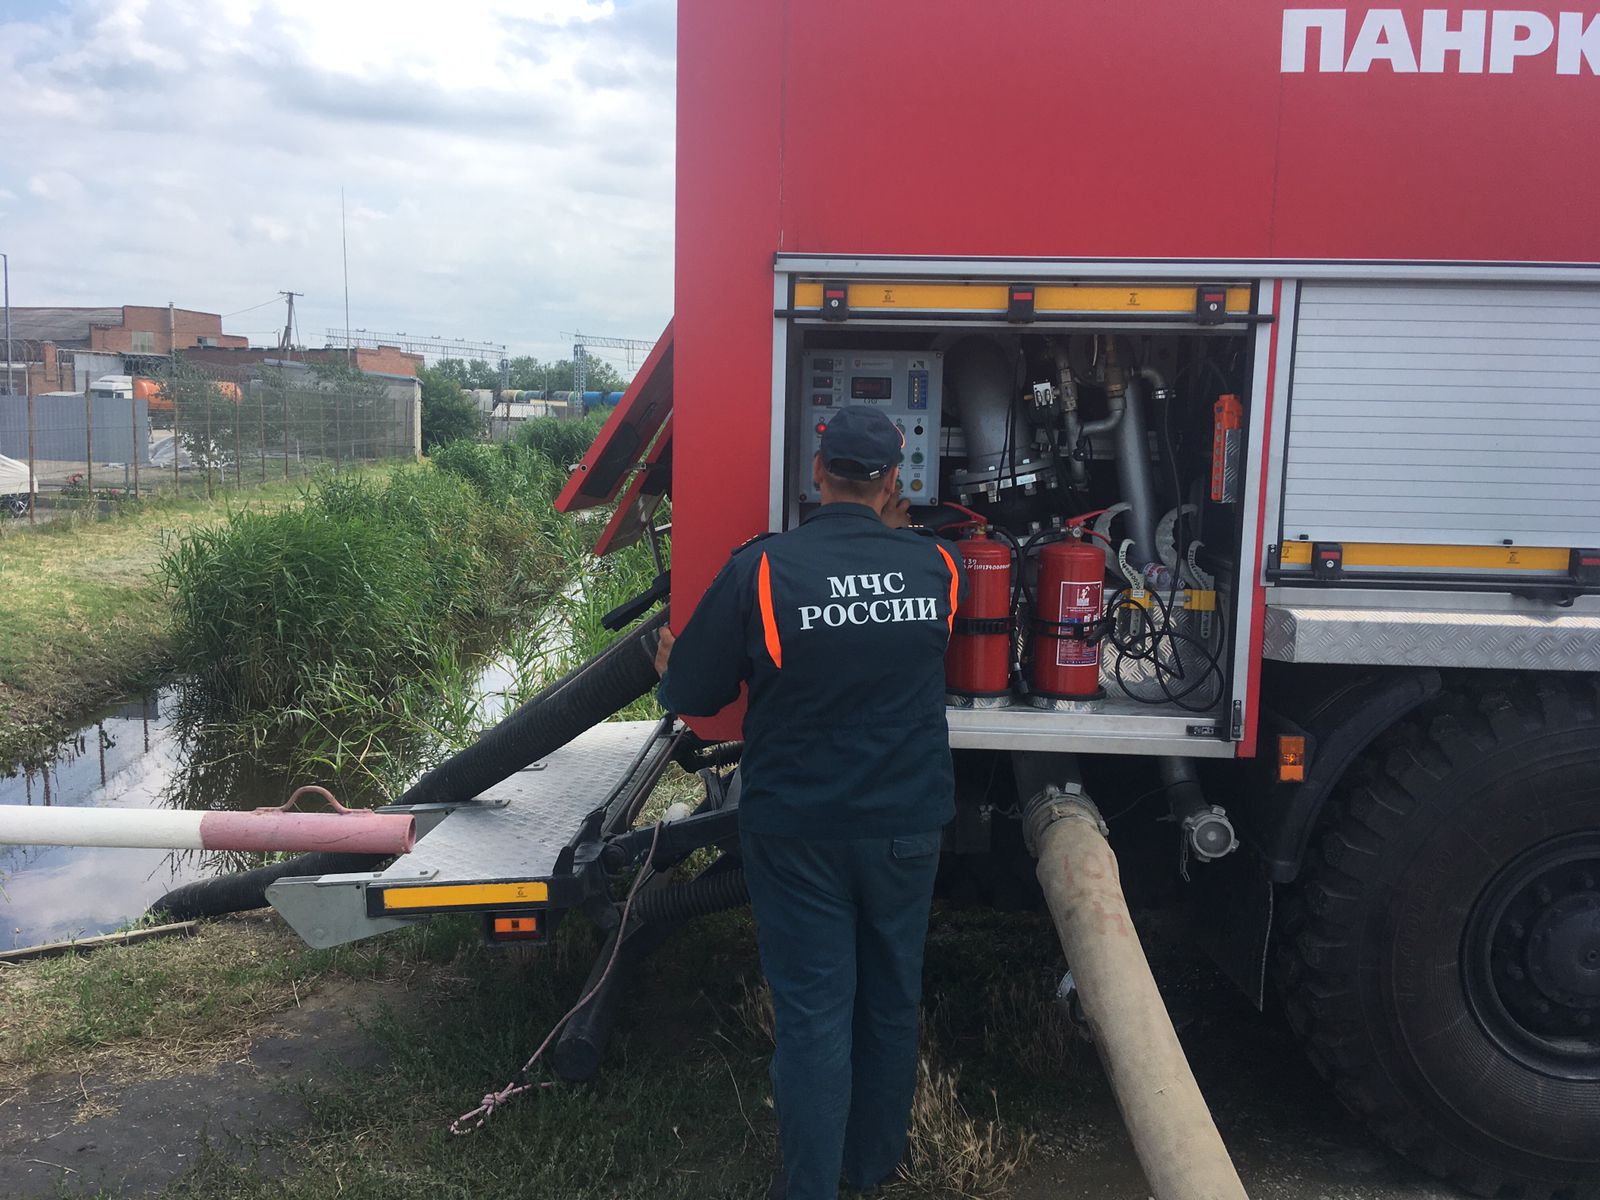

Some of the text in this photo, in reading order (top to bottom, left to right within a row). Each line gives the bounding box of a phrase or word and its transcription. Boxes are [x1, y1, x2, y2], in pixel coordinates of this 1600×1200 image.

[1280, 8, 1600, 76] ПАНРК
[827, 571, 906, 598] МЧС
[798, 597, 938, 630] РОССИИ
